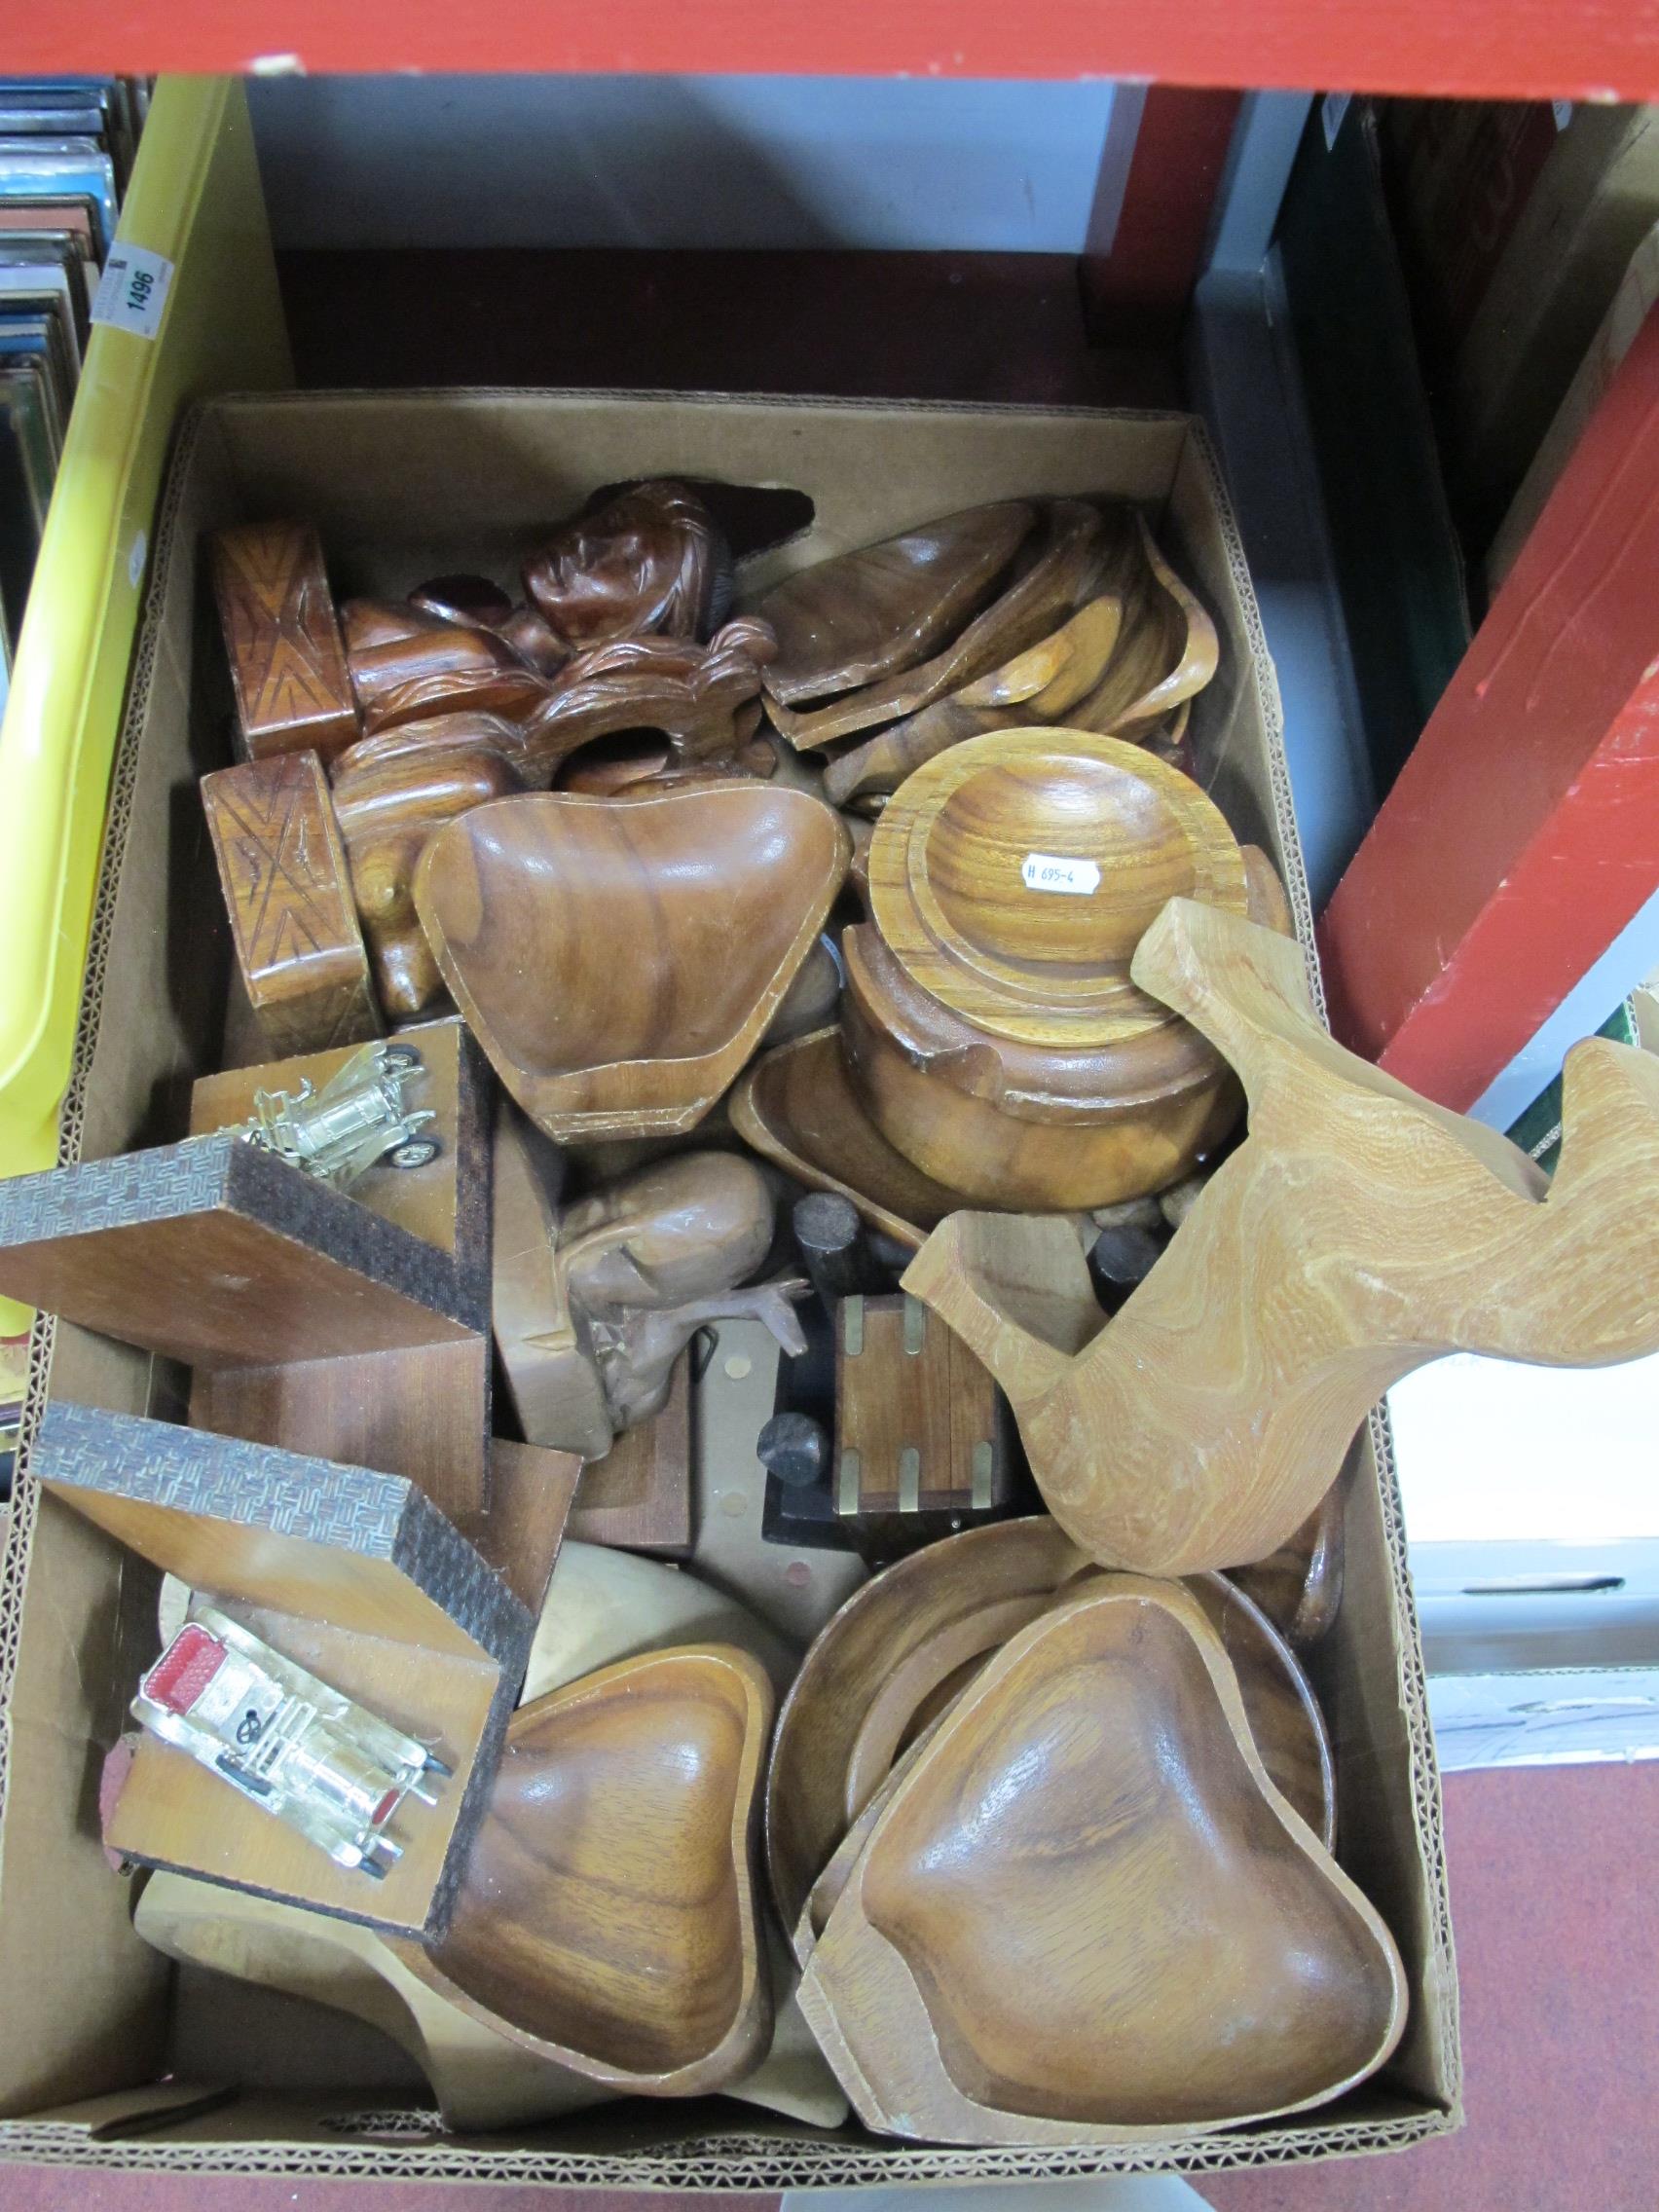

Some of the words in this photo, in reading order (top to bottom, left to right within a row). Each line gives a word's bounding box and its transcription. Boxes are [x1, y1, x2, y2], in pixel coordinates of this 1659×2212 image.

[127, 271, 155, 312] 1496
[1027, 864, 1036, 878] H
[1041, 867, 1074, 883] 695-4
